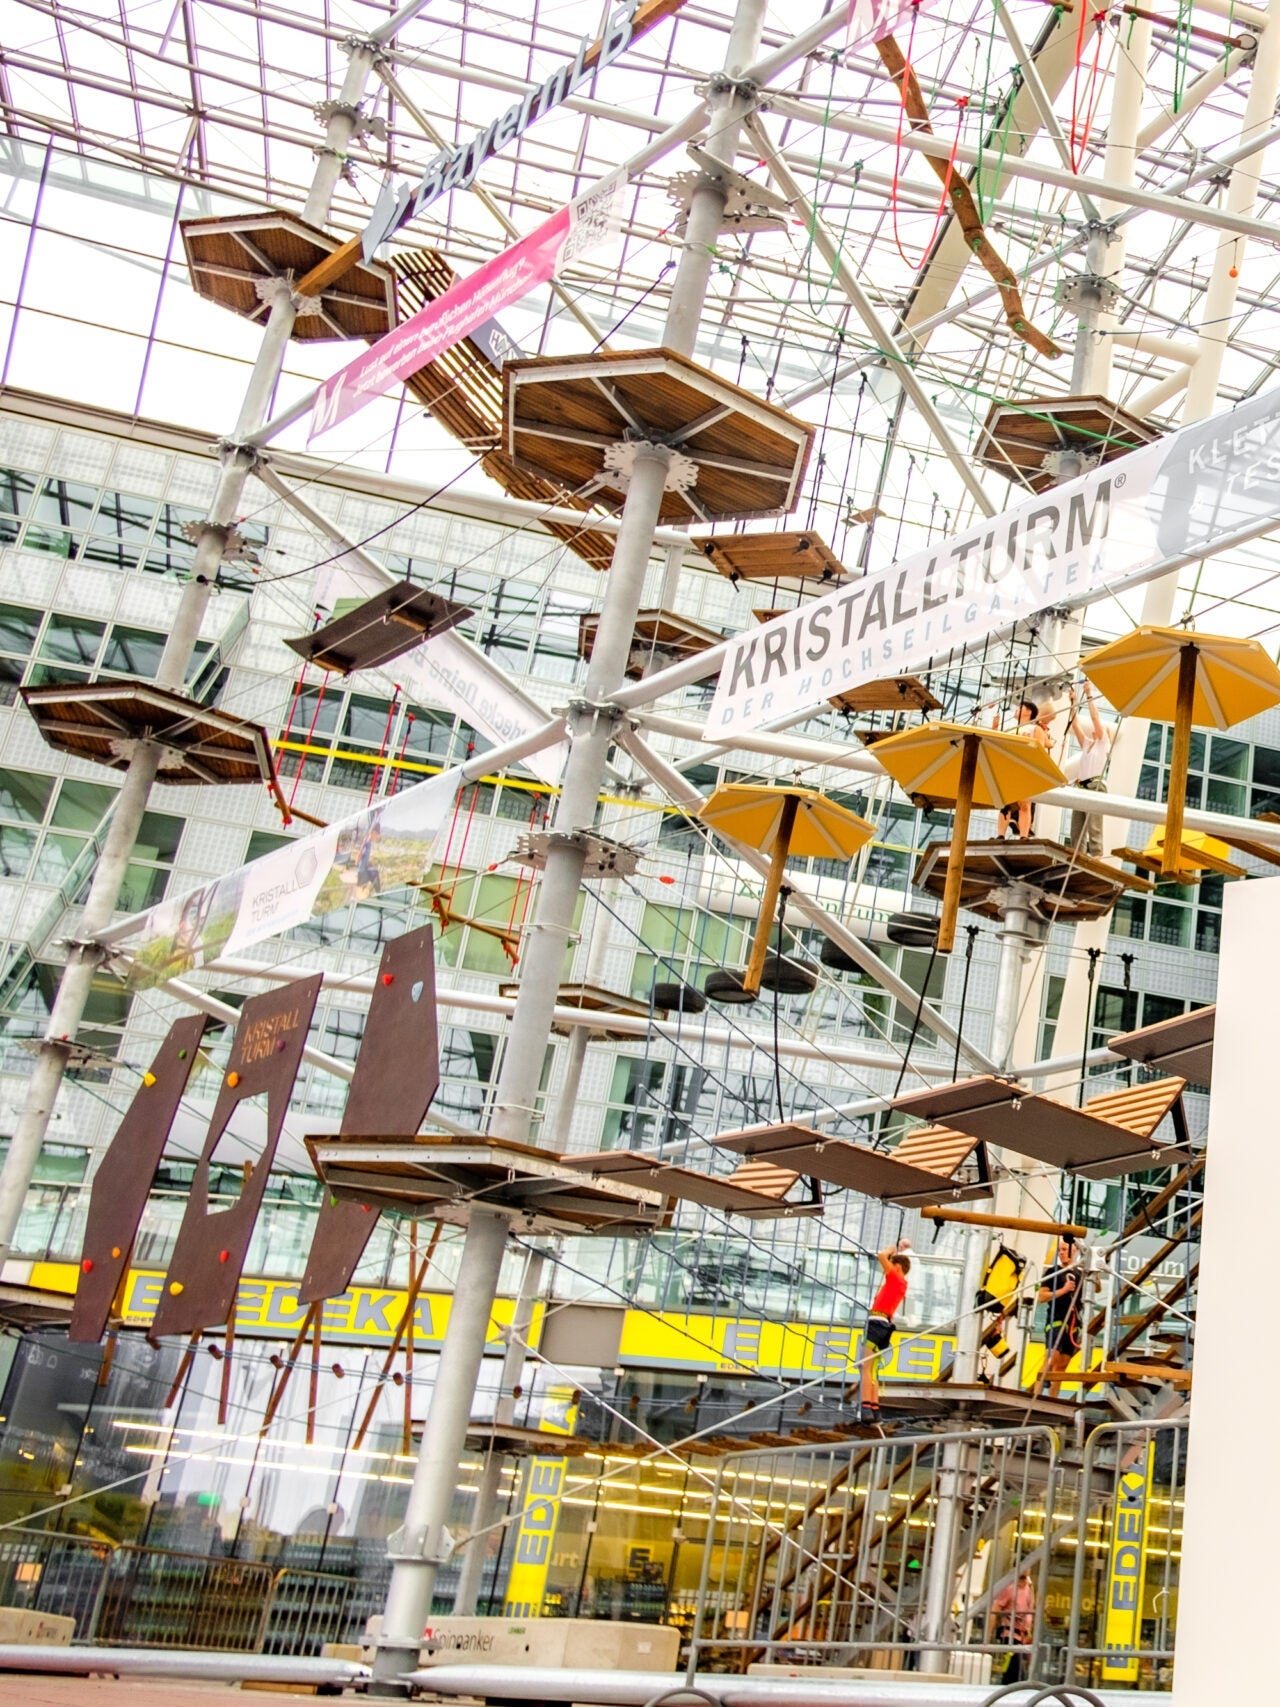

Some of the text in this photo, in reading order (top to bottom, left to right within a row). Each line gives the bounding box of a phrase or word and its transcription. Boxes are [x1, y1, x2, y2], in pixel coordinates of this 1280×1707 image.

[412, 0, 638, 217] BayernLB
[721, 691, 774, 727] DER
[722, 1323, 762, 1361] E
